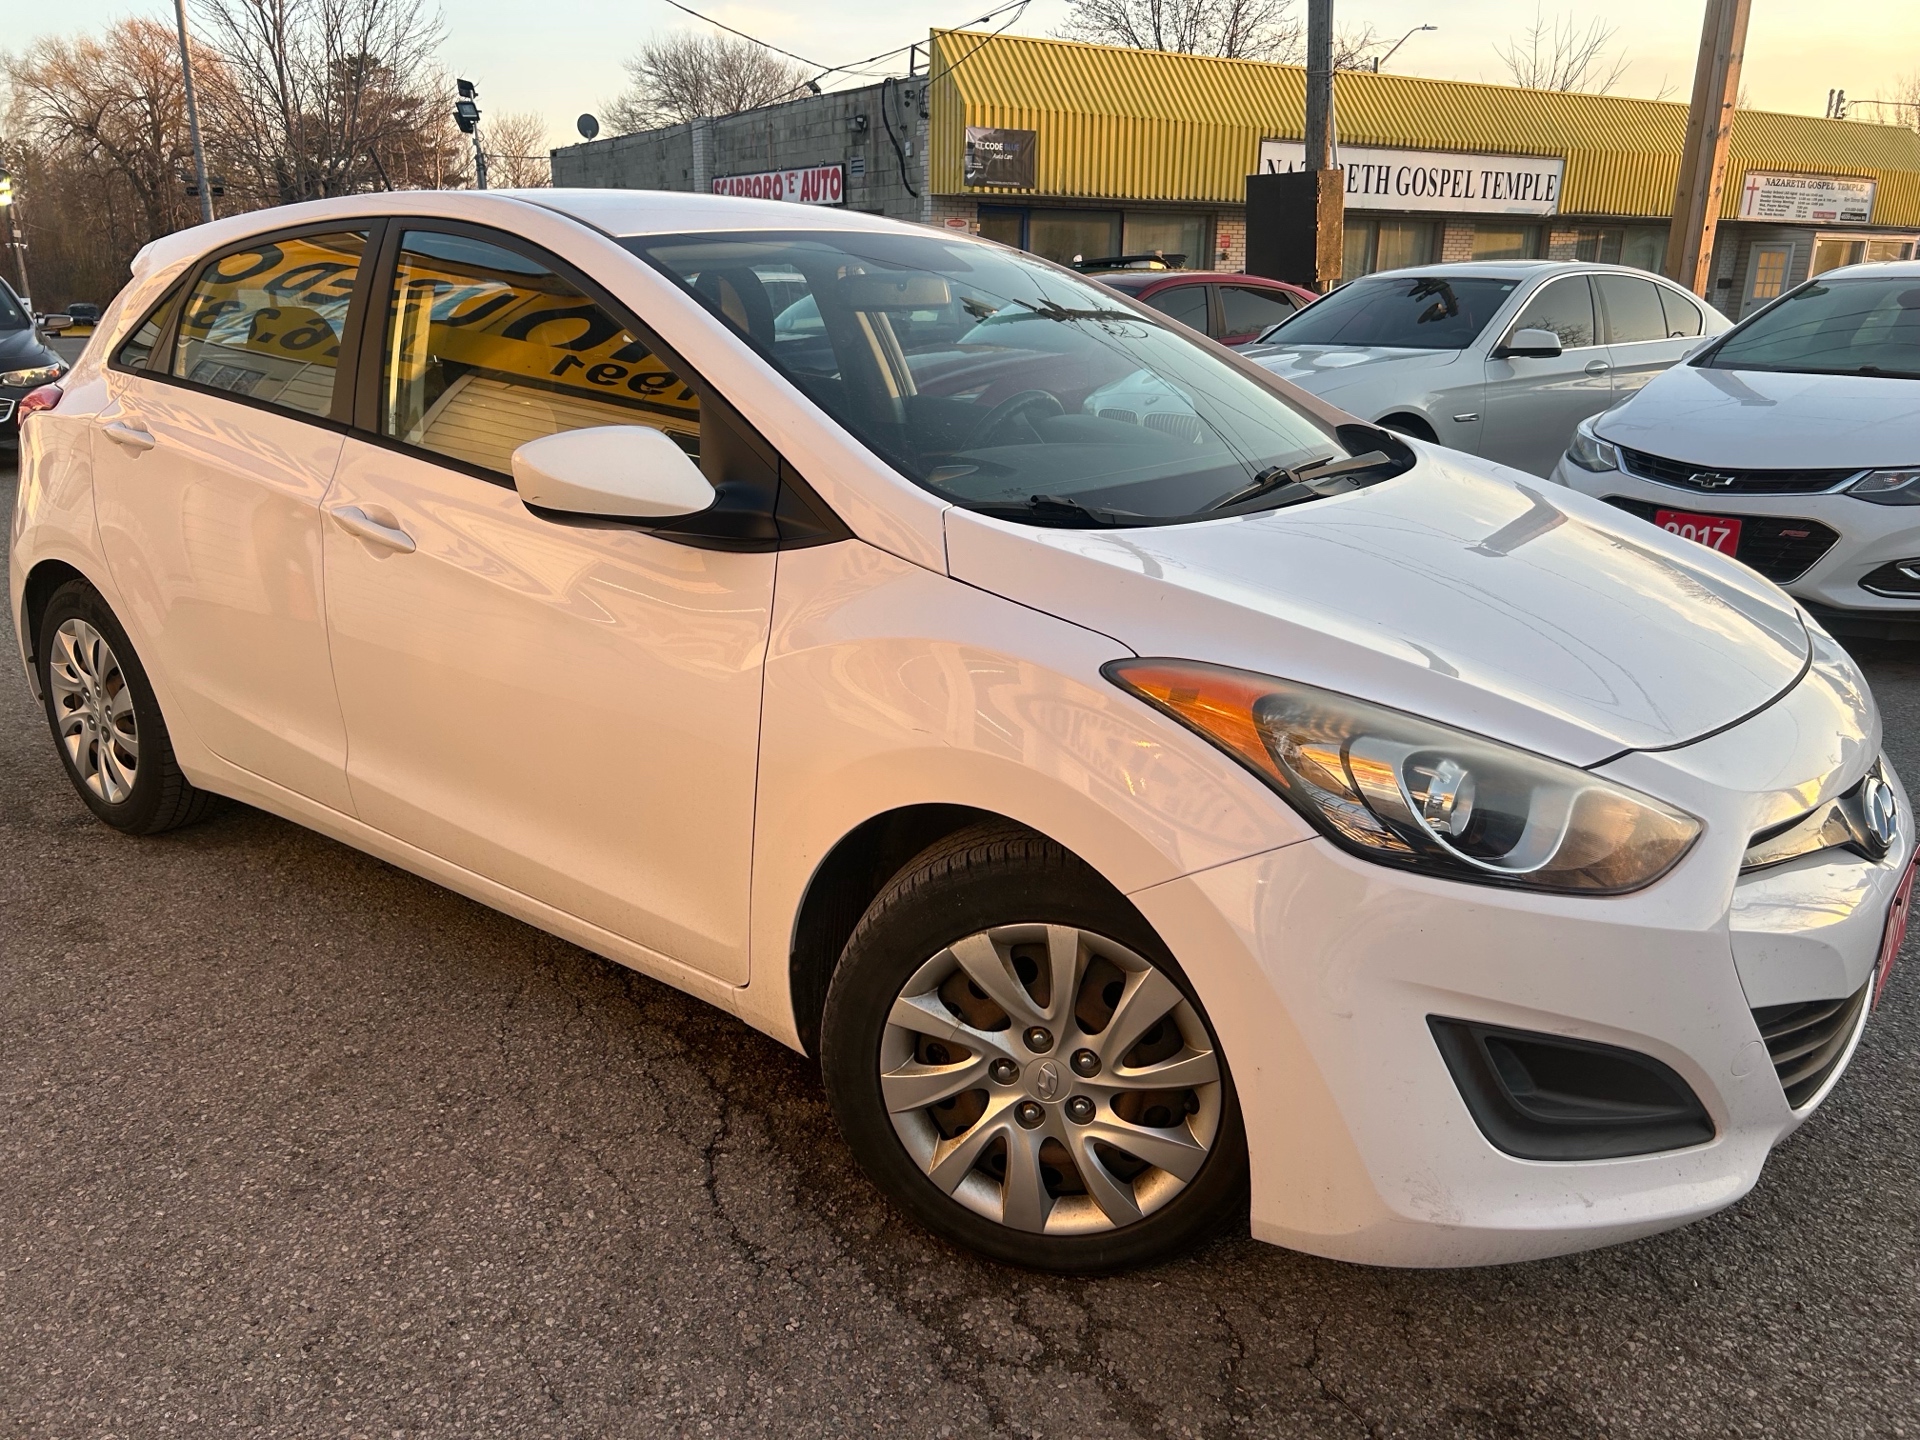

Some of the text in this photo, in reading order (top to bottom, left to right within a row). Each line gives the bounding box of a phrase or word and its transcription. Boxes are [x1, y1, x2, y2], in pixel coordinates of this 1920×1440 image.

[800, 167, 841, 202] AUTO
[1395, 166, 1476, 199] GOSPEL
[1480, 170, 1557, 202] TEMPLE
[1765, 177, 1865, 192] NAZARETH GOSPEL TEMPLE
